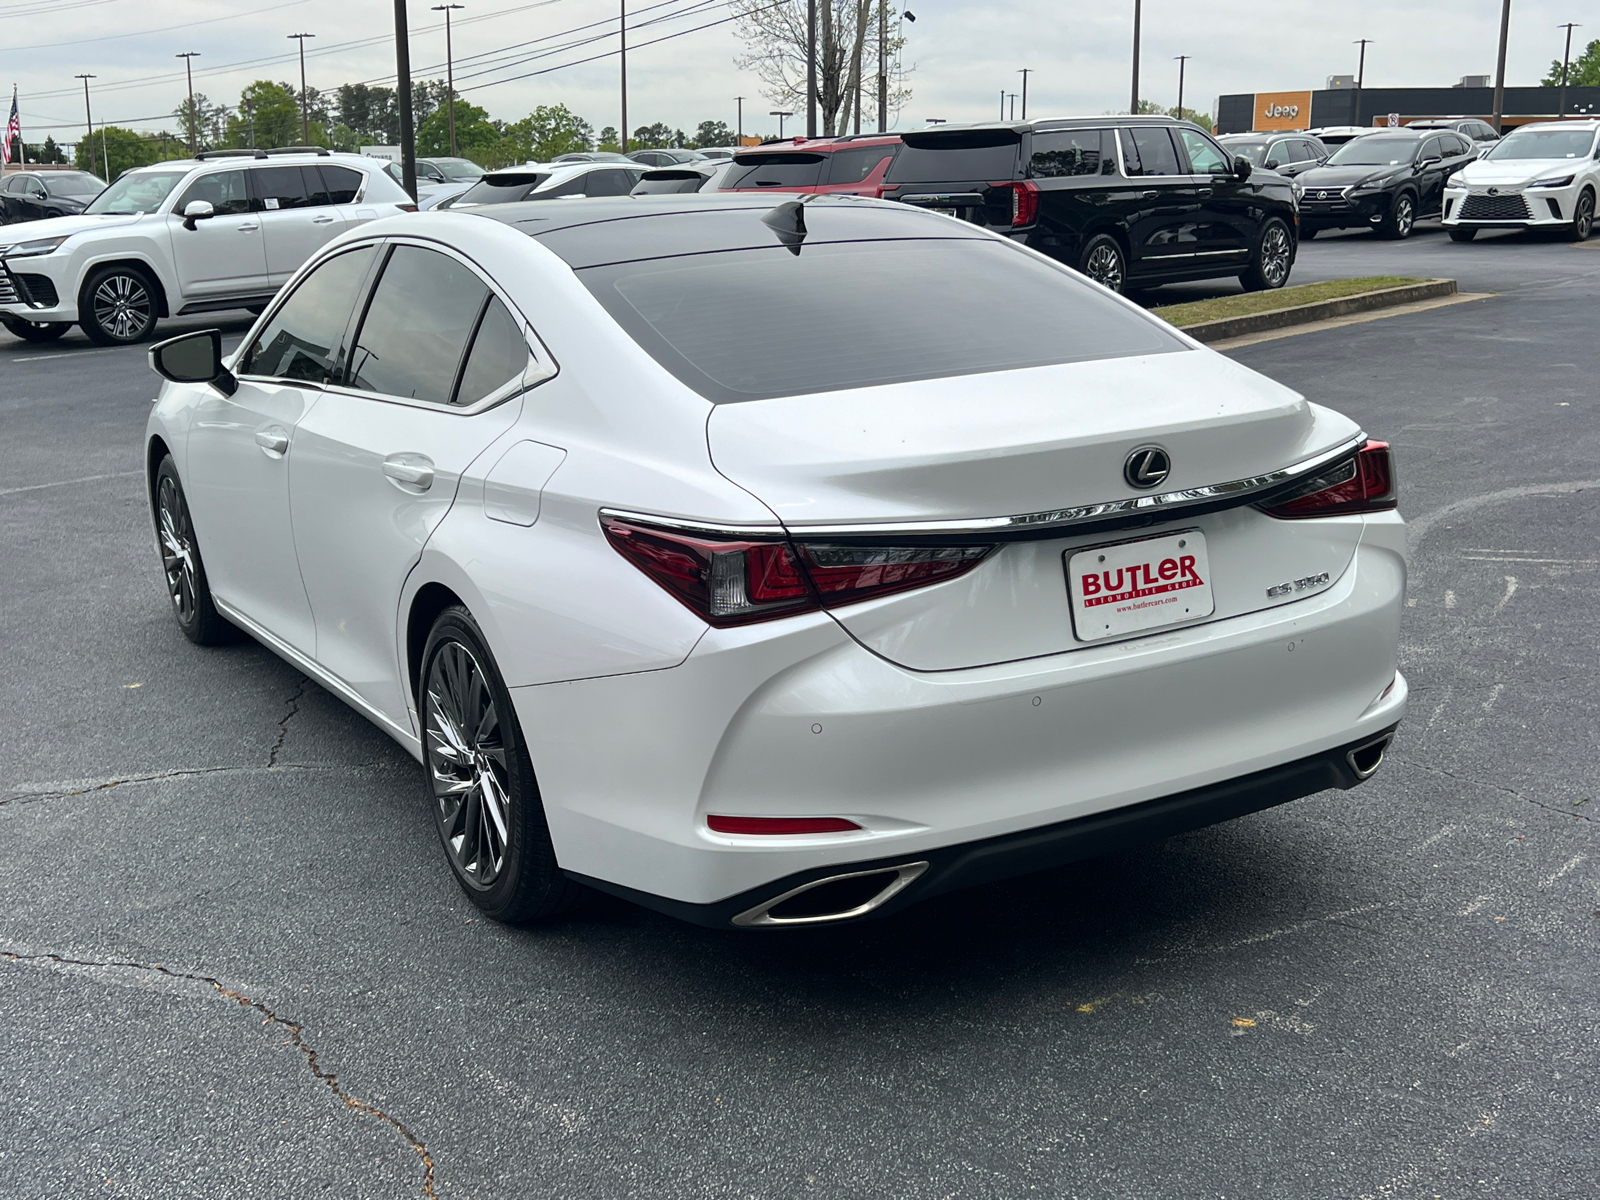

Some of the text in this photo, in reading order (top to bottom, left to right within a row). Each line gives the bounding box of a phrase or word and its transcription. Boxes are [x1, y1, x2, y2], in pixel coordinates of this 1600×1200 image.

[1265, 102, 1299, 120] Jeep
[1084, 578, 1200, 607] AUTOMOTIVE GROUP
[1266, 572, 1330, 599] ES 350
[1116, 596, 1178, 613] www.butlercars.com
